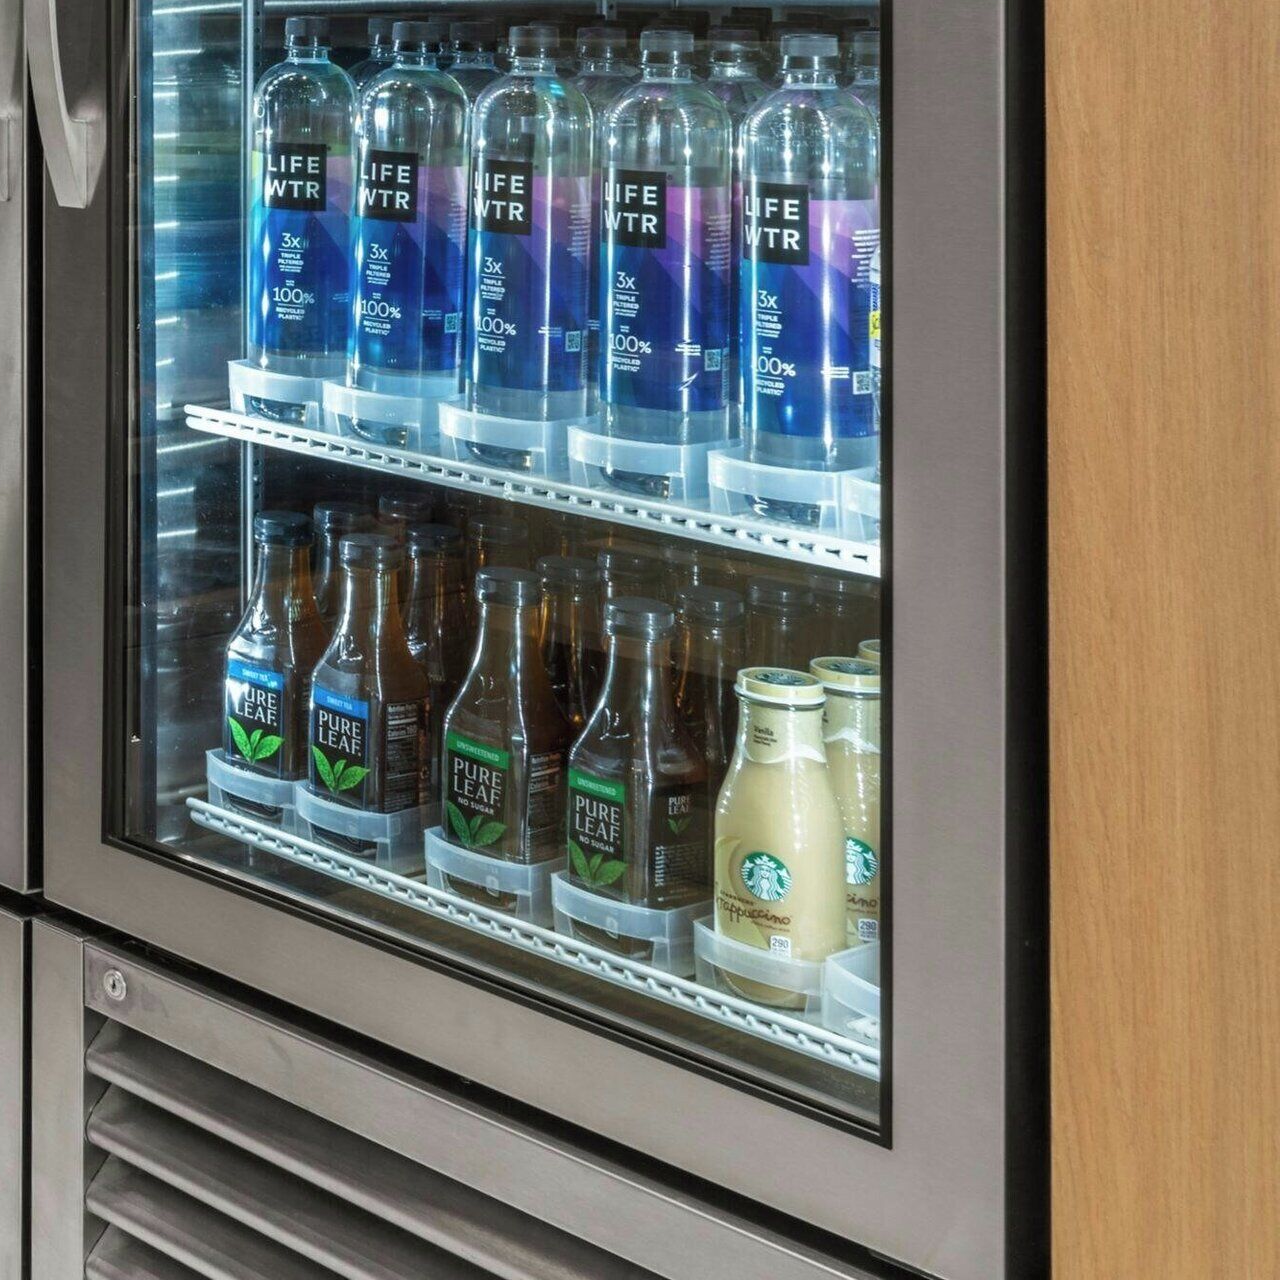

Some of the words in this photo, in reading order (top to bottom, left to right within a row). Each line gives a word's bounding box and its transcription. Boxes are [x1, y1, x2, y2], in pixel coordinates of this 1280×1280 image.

[267, 157, 320, 173] LIFE
[360, 163, 410, 184] LIFE
[268, 180, 320, 199] WTR
[472, 171, 525, 194] LIFE
[605, 181, 658, 205] LIFE
[360, 189, 409, 209] WTR
[746, 195, 799, 220] LIFE
[473, 201, 524, 221] WTR
[605, 210, 657, 234] WTR
[745, 225, 799, 250] WTR
[319, 710, 361, 739] PURE
[454, 758, 502, 790] PURE
[458, 797, 470, 806] NO
[472, 800, 495, 815] SUGAR
[575, 796, 620, 826] PURE
